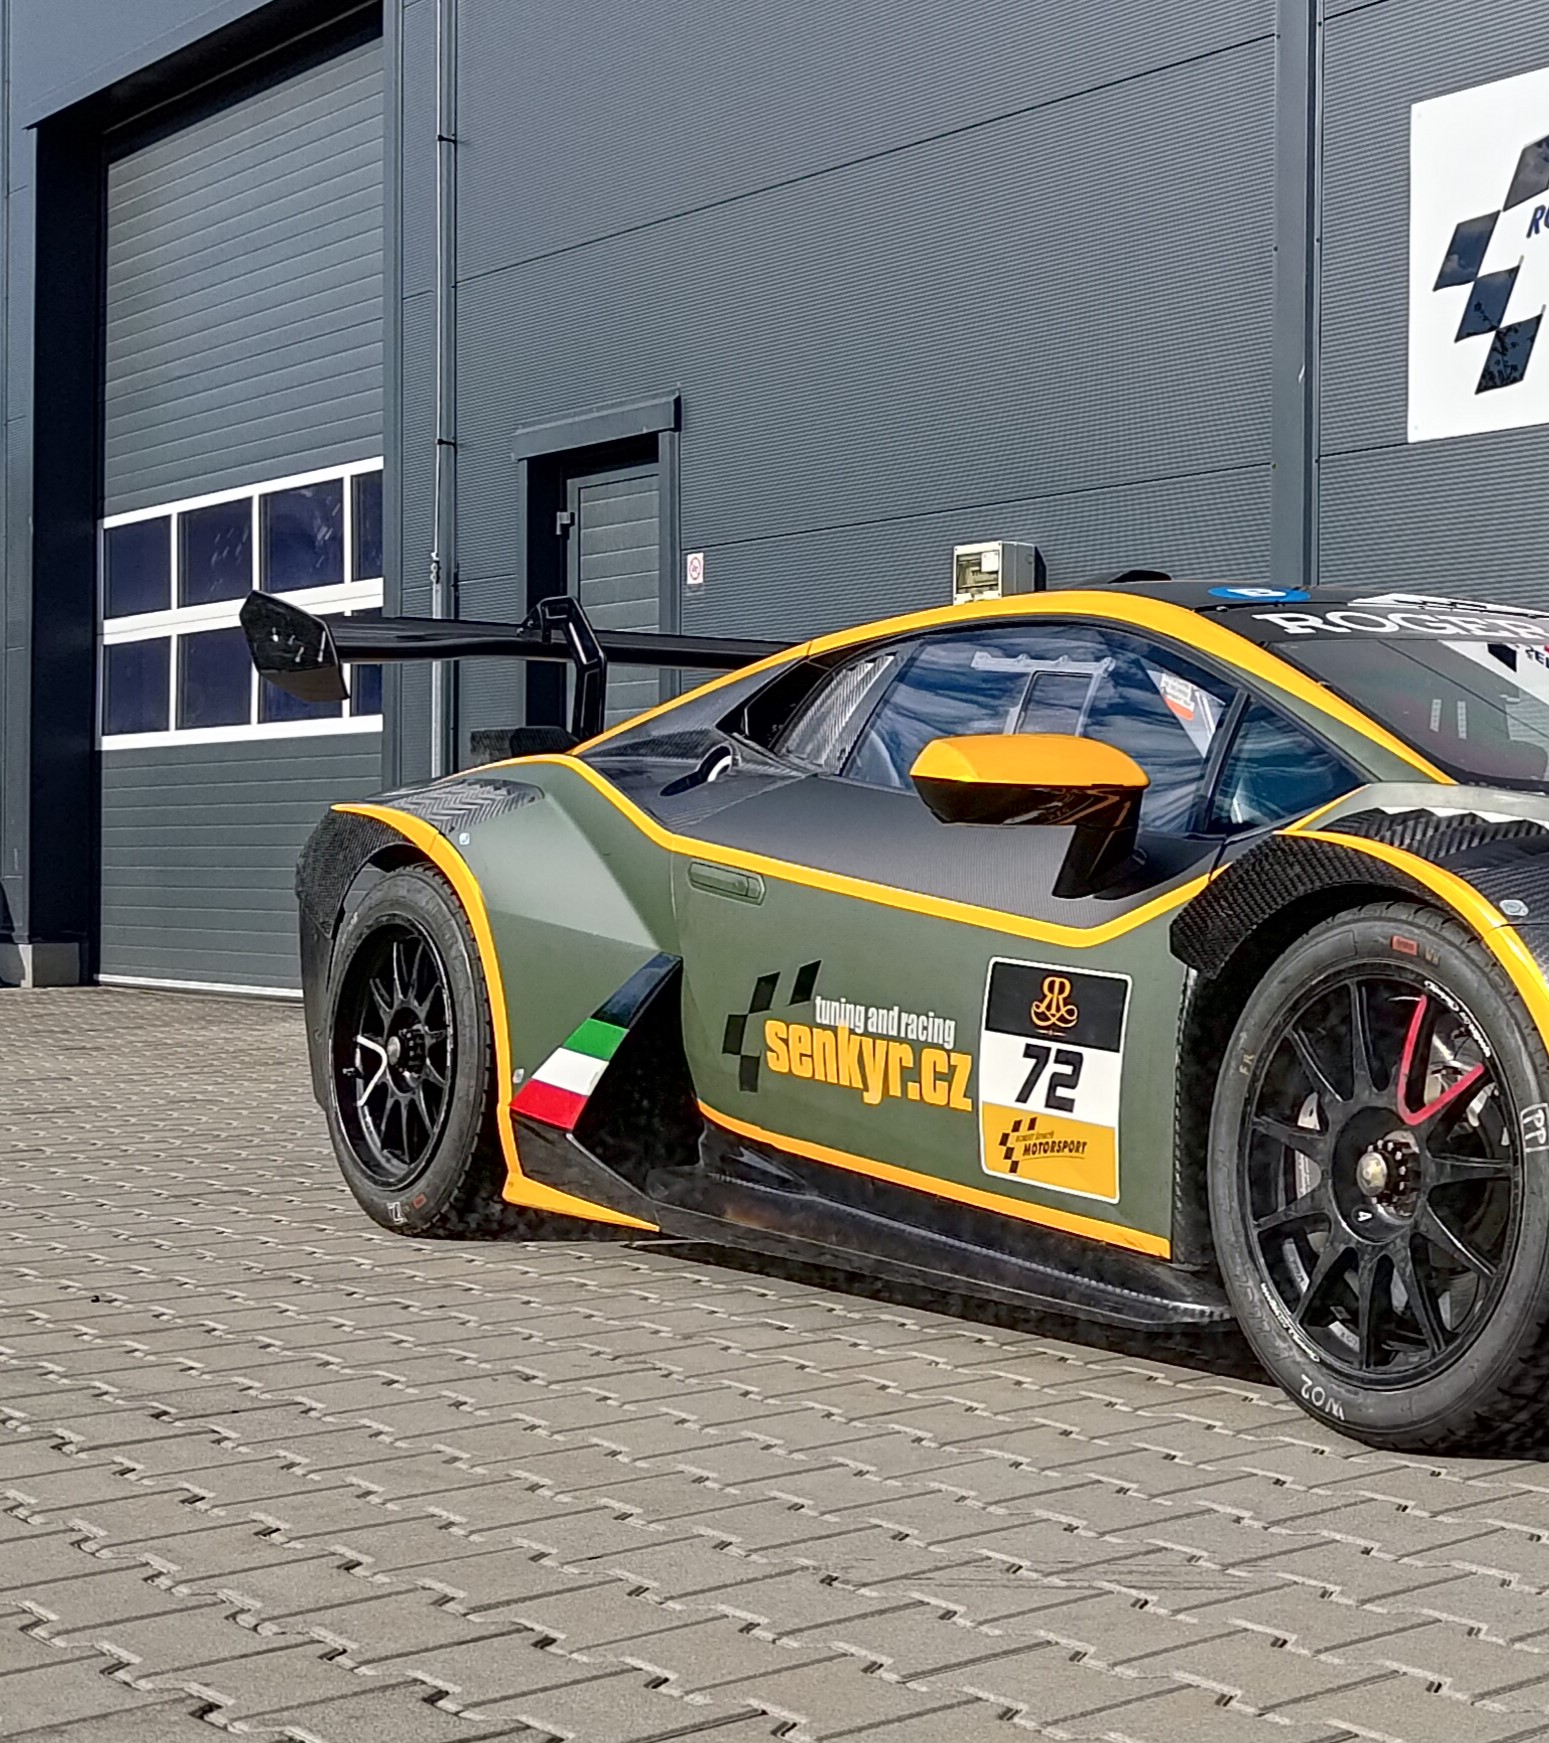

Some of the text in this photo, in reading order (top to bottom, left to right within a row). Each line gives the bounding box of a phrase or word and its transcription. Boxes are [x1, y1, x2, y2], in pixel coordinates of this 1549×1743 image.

[815, 995, 956, 1050] tuning and racing
[764, 1017, 973, 1112] senkyr.cz
[1014, 1043, 1084, 1113] 72
[1022, 1139, 1088, 1157] MOTORSPORT
